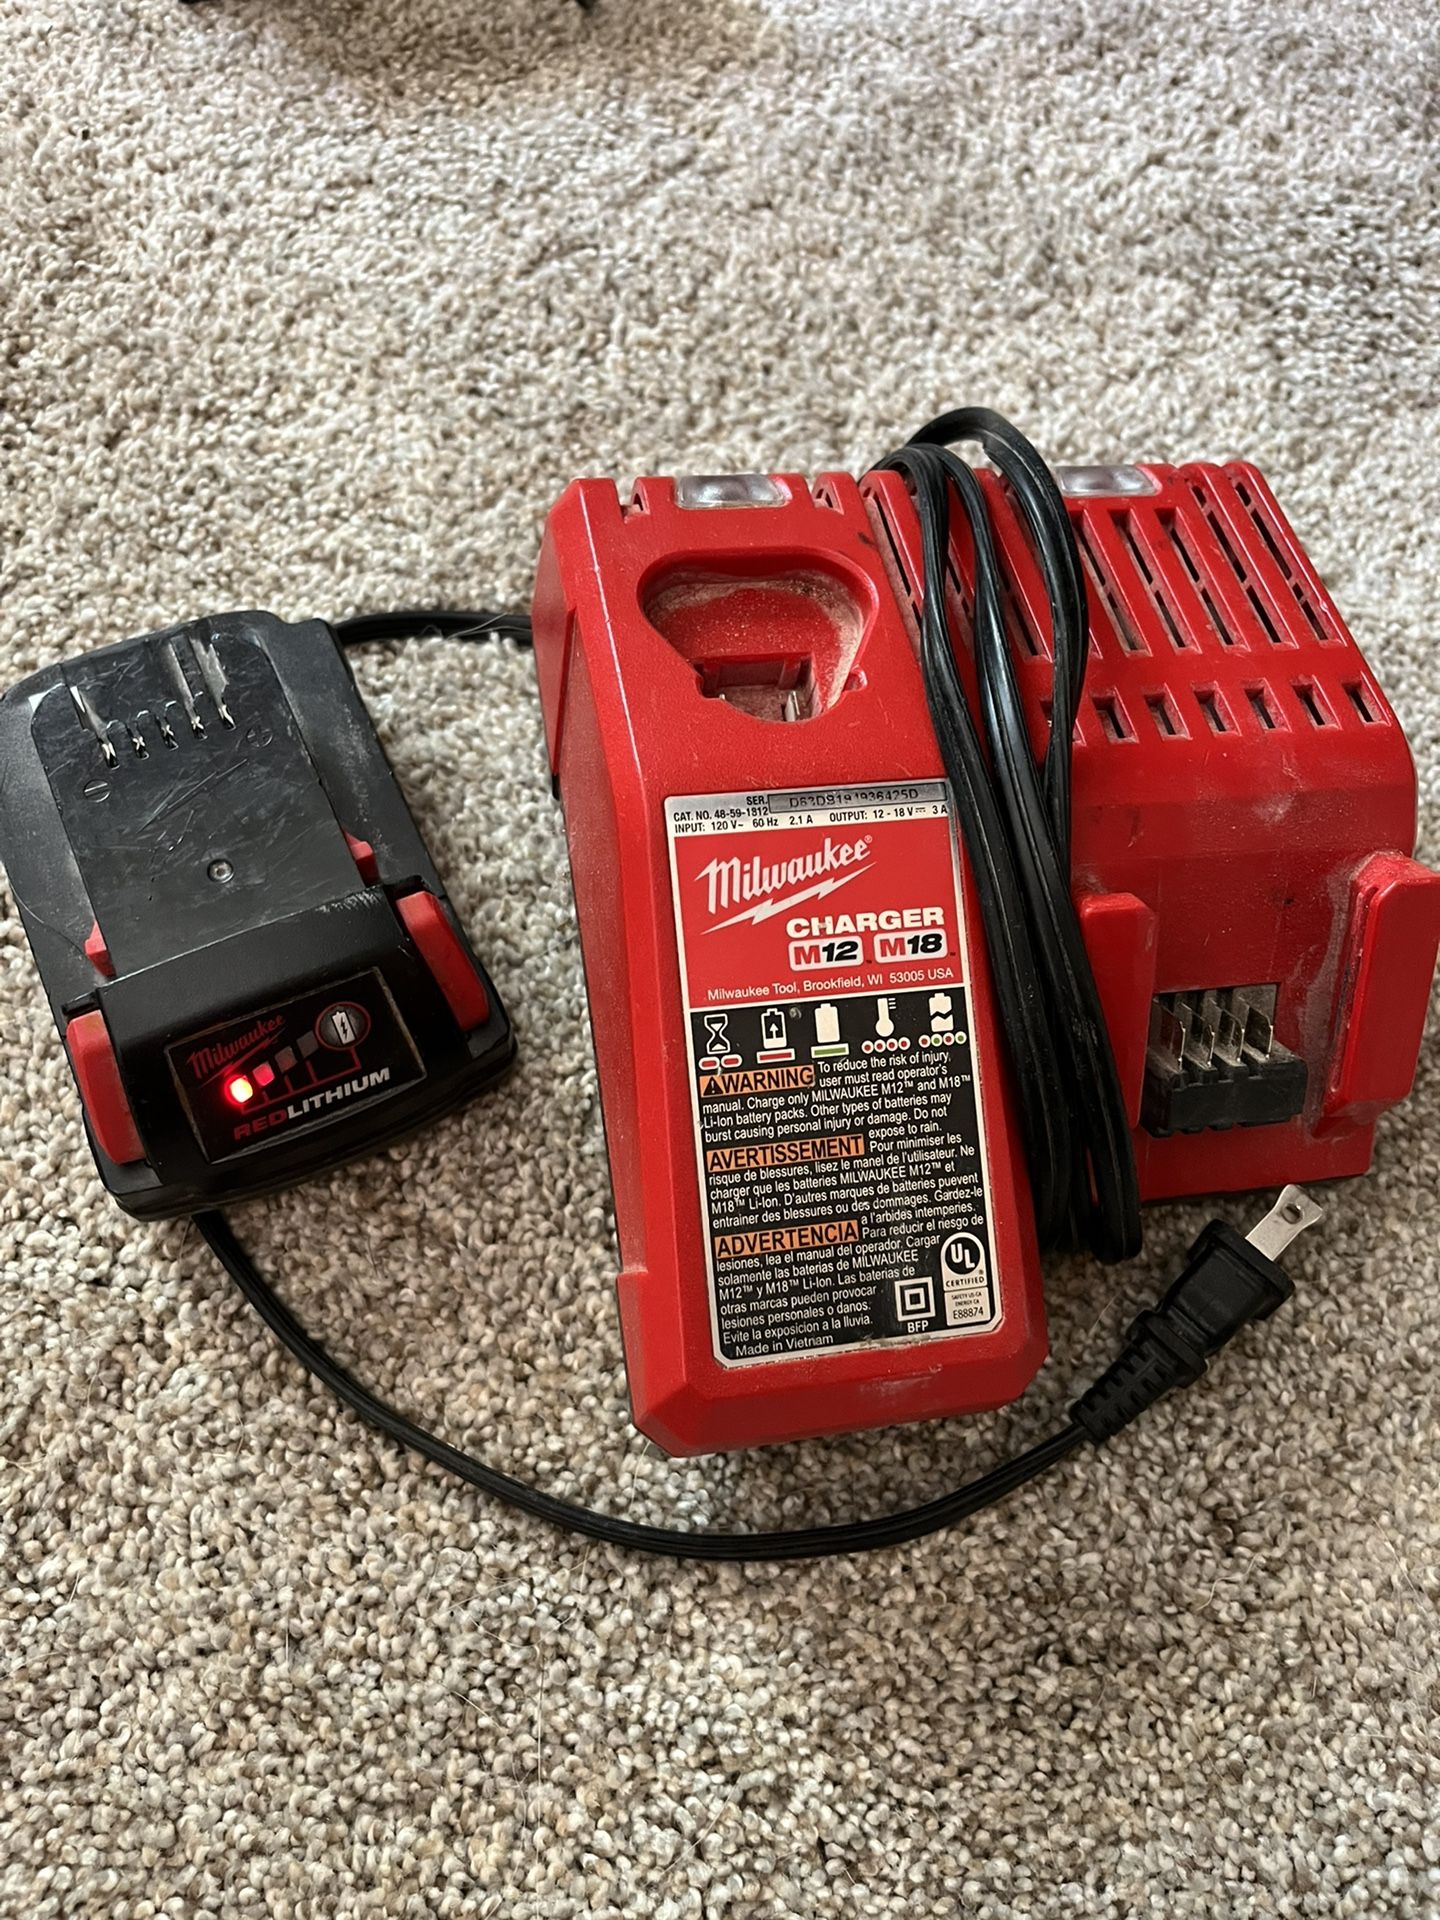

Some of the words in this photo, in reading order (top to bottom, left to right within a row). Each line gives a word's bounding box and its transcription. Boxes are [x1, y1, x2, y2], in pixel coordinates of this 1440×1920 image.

[673, 811, 693, 822] CAT.
[695, 809, 712, 820] NO.
[714, 805, 768, 819] 48-59-1812
[746, 795, 768, 806] SER.
[674, 822, 705, 833] INPUT:
[711, 820, 728, 830] 120
[752, 817, 765, 828] 60
[766, 816, 778, 827] Hz
[789, 815, 802, 825] 2.1
[806, 814, 813, 824] A
[829, 810, 867, 822] OUTPUT:
[872, 809, 884, 819] 12
[893, 807, 905, 817] 18
[931, 805, 938, 815] 3
[940, 804, 948, 814] A
[786, 906, 944, 938] CHARGER
[792, 940, 859, 965] M12
[878, 932, 943, 957] M18
[707, 986, 770, 1000] Milwaukee
[771, 981, 800, 994] Tool,
[802, 975, 865, 992] Brookfield,
[866, 973, 883, 985] WI
[889, 969, 925, 984] 53005
[927, 967, 954, 980] USA
[186, 1015, 285, 1080] Milwaukee
[817, 1060, 830, 1073] To
[832, 1059, 868, 1072] reduce
[870, 1056, 886, 1068] the
[888, 1053, 907, 1066] risk
[909, 1051, 919, 1064] of
[721, 1066, 813, 1093] WARNING
[819, 1076, 842, 1087] user
[844, 1071, 870, 1085] must
[871, 1068, 895, 1082] read
[897, 1063, 948, 1082] operator's
[702, 1098, 744, 1114] manual.
[746, 1096, 785, 1110] Charge
[787, 1091, 809, 1106] only
[811, 1083, 879, 1102] MILWAUKEE
[917, 1078, 936, 1091] and
[703, 1115, 733, 1129] Li-Ion
[735, 1111, 772, 1125] battery
[774, 1106, 808, 1123] packs.
[810, 1103, 840, 1117] Other
[841, 1101, 870, 1116] types
[871, 1097, 882, 1110] of
[884, 1095, 928, 1109] batteries
[930, 1093, 952, 1105] may
[704, 1128, 732, 1143] burst
[733, 1124, 774, 1140] causing
[776, 1118, 821, 1137] personal
[823, 1116, 851, 1132] injury
[853, 1116, 865, 1126] or
[866, 1111, 911, 1125] damage.
[913, 1107, 929, 1120] Do
[930, 1105, 947, 1118] not
[868, 1125, 905, 1140] expose
[907, 1123, 918, 1134] to
[919, 1122, 942, 1133] rain.
[869, 1140, 894, 1153] Pour
[896, 1134, 945, 1149] minimiser
[946, 1132, 962, 1144] les
[708, 1135, 863, 1170] AVERTISSEMENT
[708, 1173, 741, 1187] risque
[743, 1169, 757, 1182] de
[759, 1164, 813, 1180] blessures,
[814, 1161, 839, 1173] lisez
[840, 1158, 850, 1170] le
[852, 1154, 884, 1171] manel
[886, 1152, 900, 1165] de
[901, 1148, 957, 1163] l'utilisateur.
[959, 1144, 975, 1156] Ne
[710, 1186, 750, 1200] charger
[752, 1183, 772, 1197] que
[774, 1180, 790, 1192] les
[792, 1174, 837, 1190] batteries
[839, 1165, 906, 1184] MILWAUKEE
[944, 1160, 955, 1172] et
[748, 1196, 781, 1210] Li-Ion.
[783, 1191, 827, 1206] D'autres
[829, 1186, 875, 1200] marques
[876, 1182, 890, 1195] de
[891, 1177, 936, 1193] batteries
[938, 1172, 979, 1189] puevent
[761, 1210, 781, 1223] des
[783, 1205, 833, 1220] blessures
[835, 1203, 849, 1214] ou
[851, 1199, 870, 1212] des
[872, 1193, 931, 1209] dommages.
[933, 1185, 983, 1202] Gardez-le
[861, 1215, 868, 1225] a
[914, 1202, 976, 1218] intemperies.
[716, 1221, 857, 1256] ADVERTENCIA
[861, 1226, 887, 1239] Para
[889, 1220, 924, 1235] reducir
[926, 1218, 936, 1231] el
[937, 1217, 969, 1230] riesgo
[970, 1213, 984, 1226] de
[716, 1257, 763, 1272] lesiones,
[765, 1253, 782, 1265] lea
[784, 1250, 794, 1263] el
[796, 1245, 834, 1261] manual
[836, 1243, 853, 1257] del
[905, 1234, 940, 1249] Cargar
[717, 1269, 772, 1286] solamente
[774, 1267, 790, 1279] las
[792, 1261, 834, 1276] baterias
[836, 1258, 849, 1271] de
[852, 1248, 919, 1269] MILWAUKEE
[950, 1242, 975, 1268] UL
[756, 1286, 763, 1299] y
[802, 1276, 835, 1290] Li-Ion.
[837, 1273, 857, 1285] Las
[858, 1267, 900, 1282] baterias
[901, 1264, 915, 1277] de
[945, 1276, 984, 1287] CERTIFIED
[720, 1302, 747, 1315] otras
[749, 1297, 788, 1311] marcas
[790, 1291, 830, 1309] pueden
[832, 1285, 877, 1303] provocar
[952, 1305, 983, 1319] E88874
[721, 1314, 765, 1330] lesiones
[767, 1306, 825, 1326] personales
[826, 1305, 834, 1315] o
[836, 1301, 871, 1314] danos.
[723, 1330, 749, 1344] Evite
[751, 1328, 762, 1340] la
[764, 1321, 820, 1339] exposicion
[822, 1320, 829, 1331] a
[831, 1317, 841, 1329] la
[843, 1315, 873, 1327] lluvia.
[907, 1319, 929, 1333] BFP
[735, 1342, 769, 1357] Made
[772, 1340, 783, 1351] in
[785, 1334, 834, 1349] Vietnam
